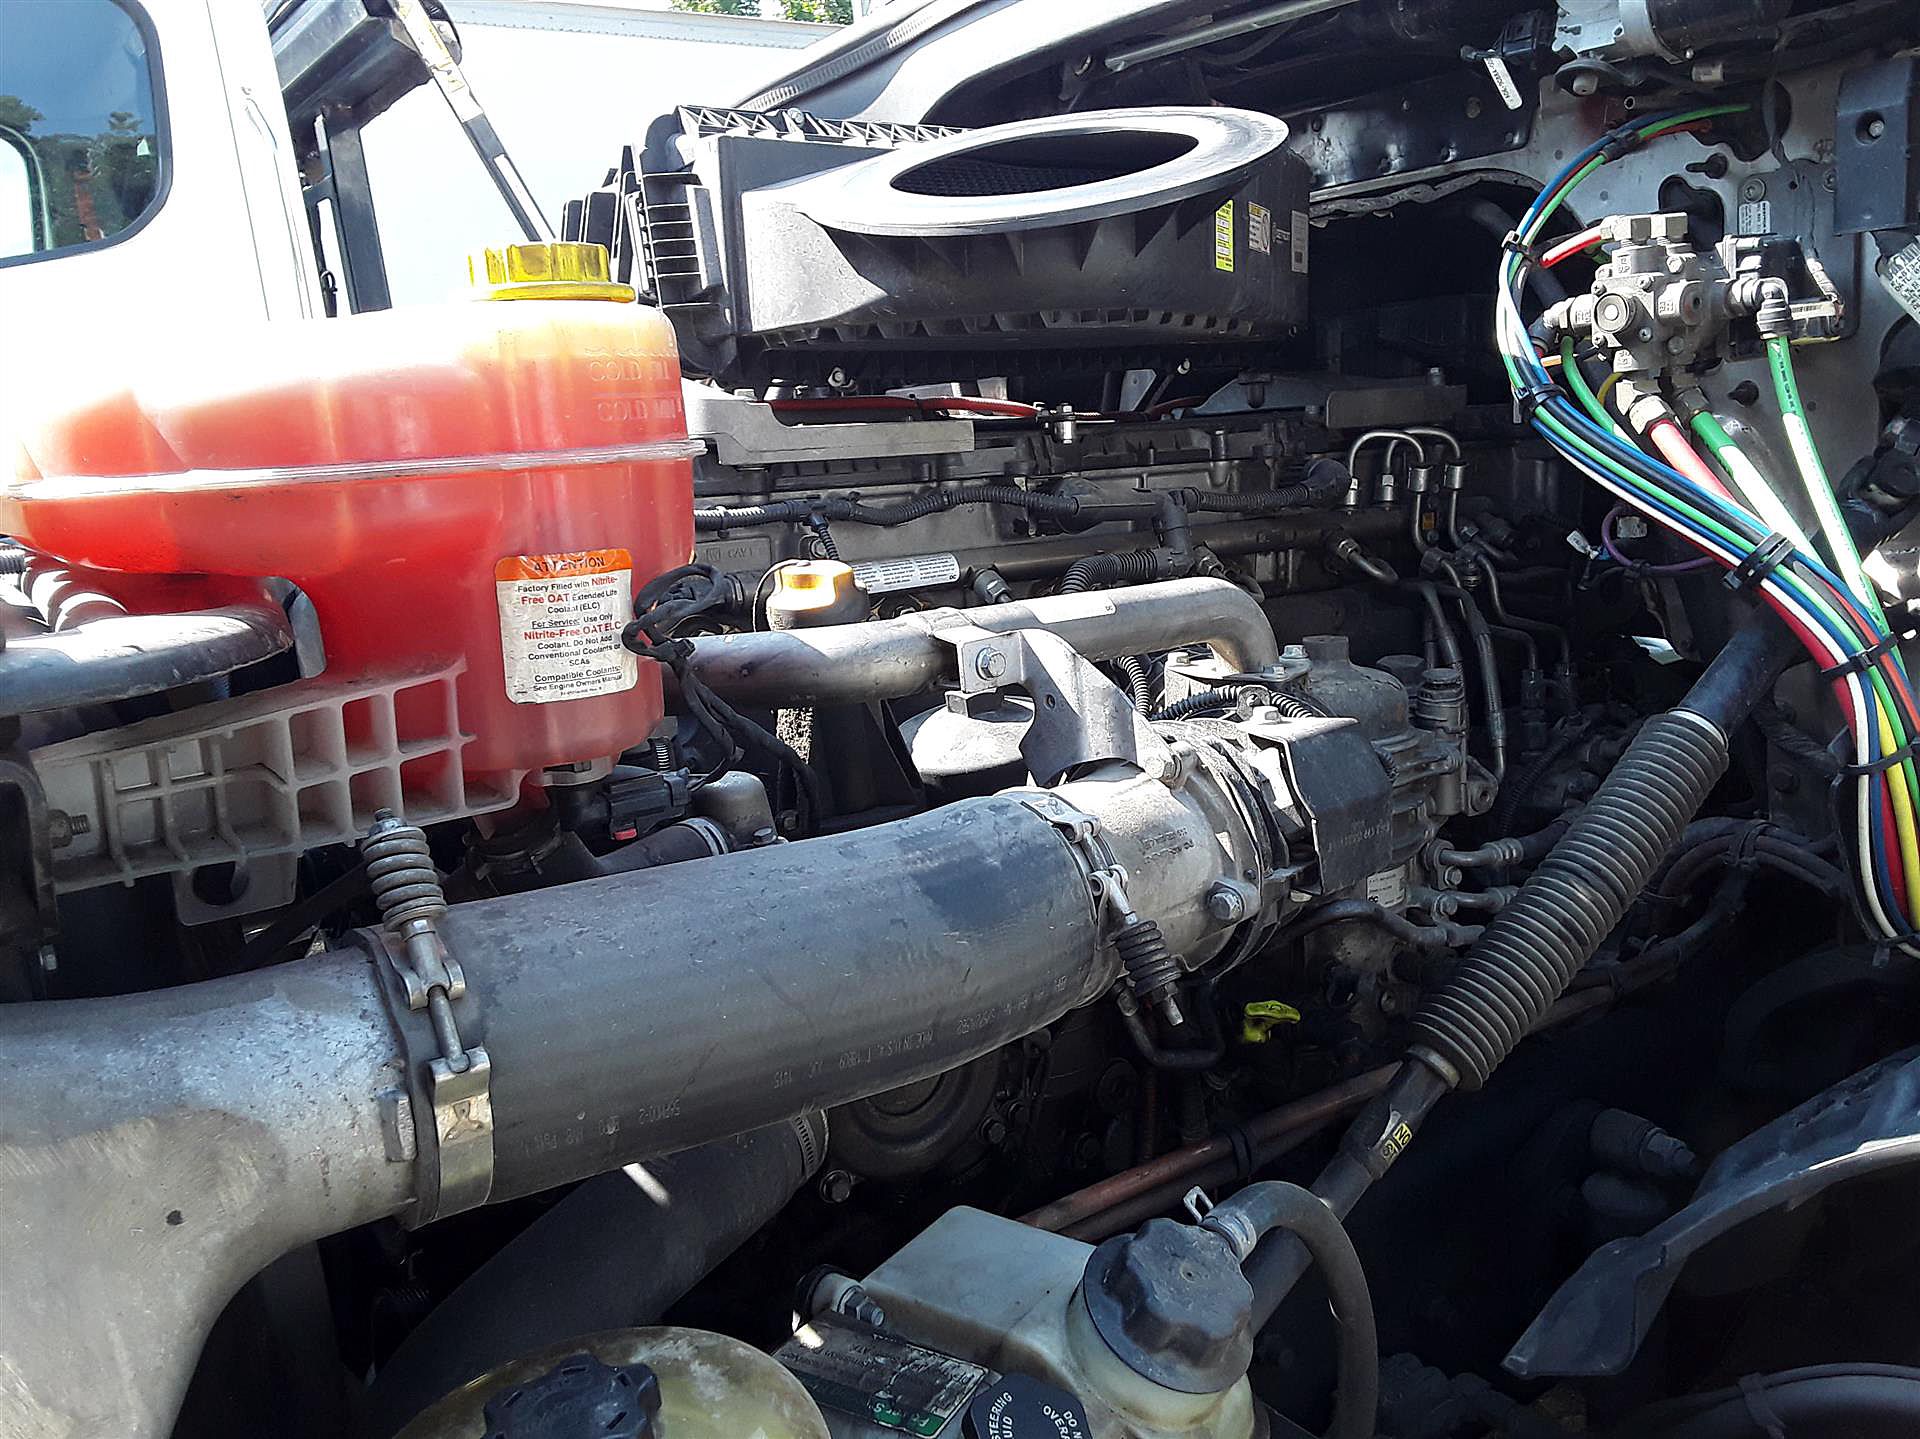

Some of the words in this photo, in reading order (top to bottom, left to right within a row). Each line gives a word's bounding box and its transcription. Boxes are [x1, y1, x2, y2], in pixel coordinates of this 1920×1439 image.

[534, 557, 606, 573] ATTENTION
[517, 584, 549, 594] Factory
[551, 583, 573, 591] Filled
[574, 581, 590, 589] with
[591, 577, 618, 587] Nitrite-
[521, 595, 545, 605] Free
[547, 593, 570, 603] OAT
[572, 590, 605, 601] Extended
[605, 589, 618, 597] Life
[580, 602, 600, 612] (ELC)
[532, 620, 546, 630] For
[583, 615, 598, 623] Use
[599, 612, 613, 621] Only
[523, 628, 580, 640] Nitrite-Free
[583, 624, 602, 635] OAT
[603, 621, 621, 632] ELC
[573, 639, 584, 647] Do
[586, 637, 599, 645] Not
[600, 634, 613, 643] Add
[528, 648, 581, 661] Conventional
[582, 644, 613, 656] Coolants
[569, 658, 590, 667] SCAs
[533, 684, 547, 692] See
[549, 682, 574, 692] Engine
[602, 673, 623, 683] Manual
[534, 671, 584, 684] Compatible
[1395, 1125, 1411, 1146] NO
[1002, 1416, 1014, 1439] UID
[1063, 1410, 1078, 1428] DO
